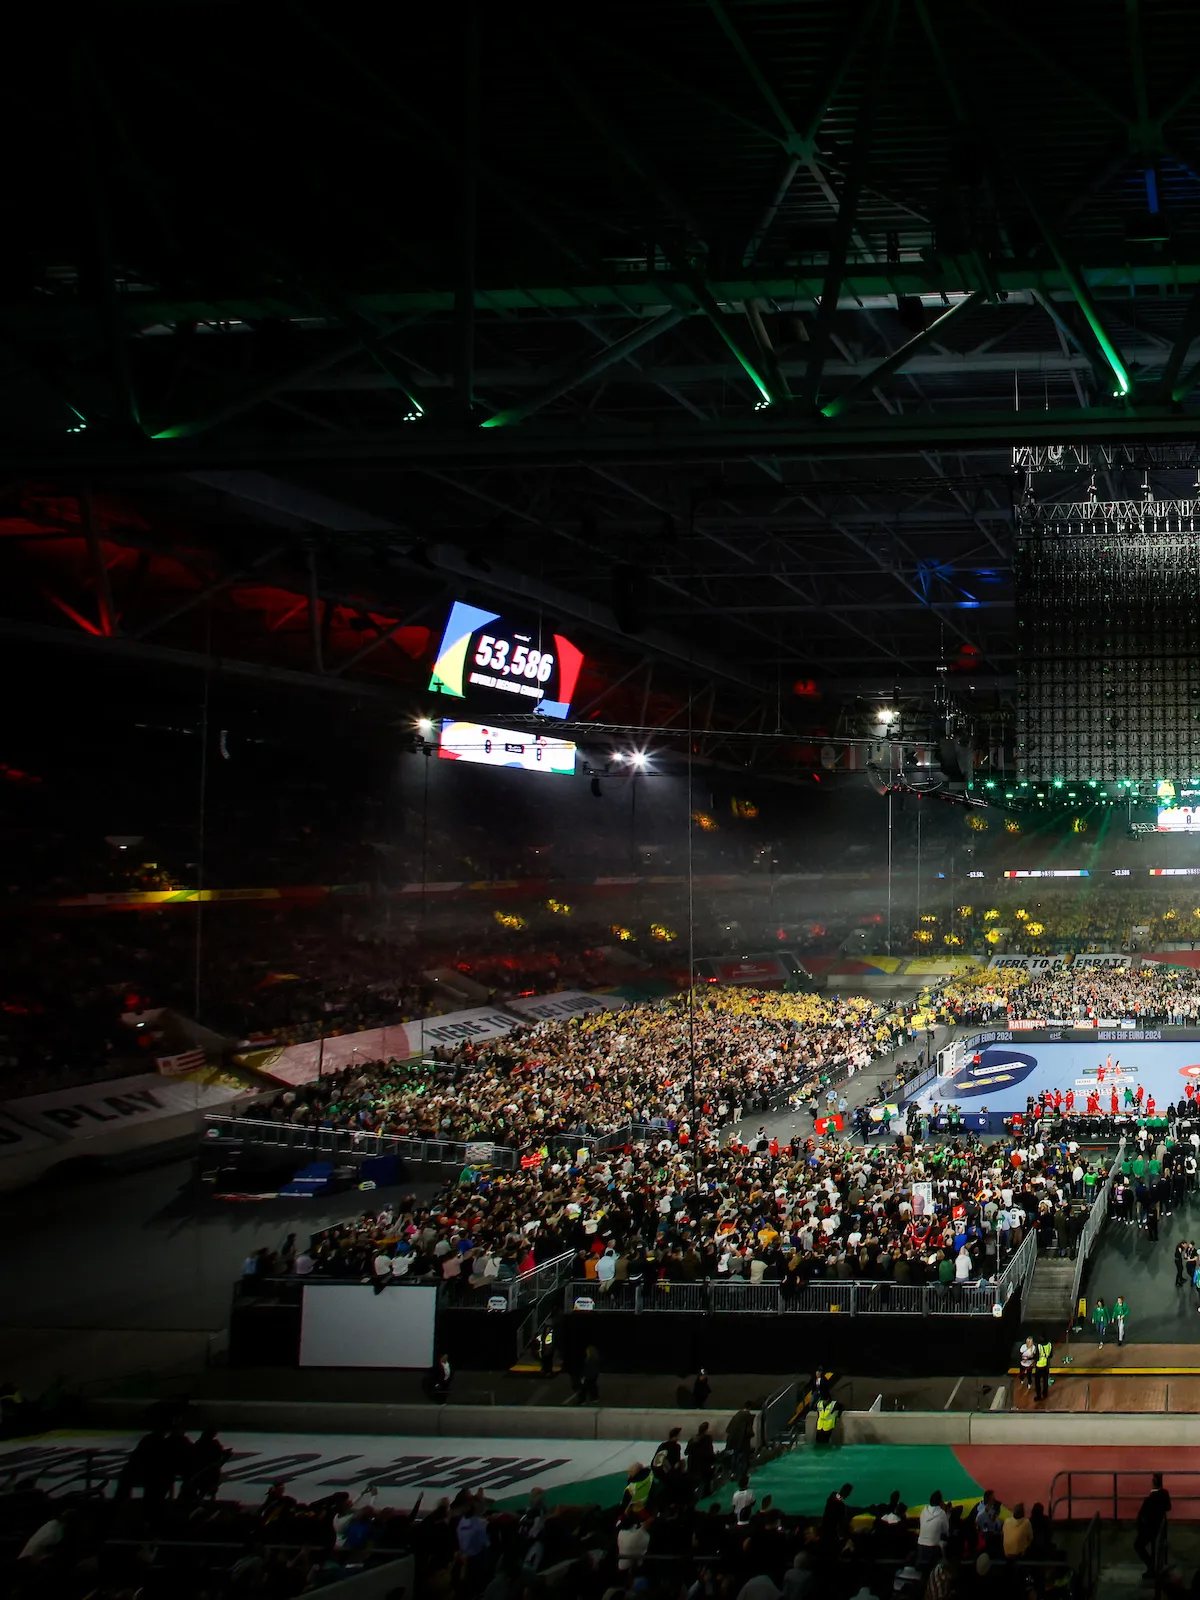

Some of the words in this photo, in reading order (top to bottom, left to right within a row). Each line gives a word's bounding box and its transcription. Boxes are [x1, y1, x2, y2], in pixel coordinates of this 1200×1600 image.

[475, 634, 553, 682] 53,586
[994, 959, 1028, 969] HERE
[1031, 959, 1049, 969] TO
[423, 1020, 481, 1042] HERE
[479, 1014, 520, 1034] TO
[528, 1004, 562, 1019] BE
[560, 995, 604, 1014] LOUD
[1116, 1031, 1128, 1040] EHF
[1128, 1031, 1145, 1040] EURO
[1145, 1031, 1162, 1040] 2024
[997, 1032, 1013, 1041] 2024
[42, 1090, 164, 1129] PLAY
[317, 1456, 573, 1490] HERE
